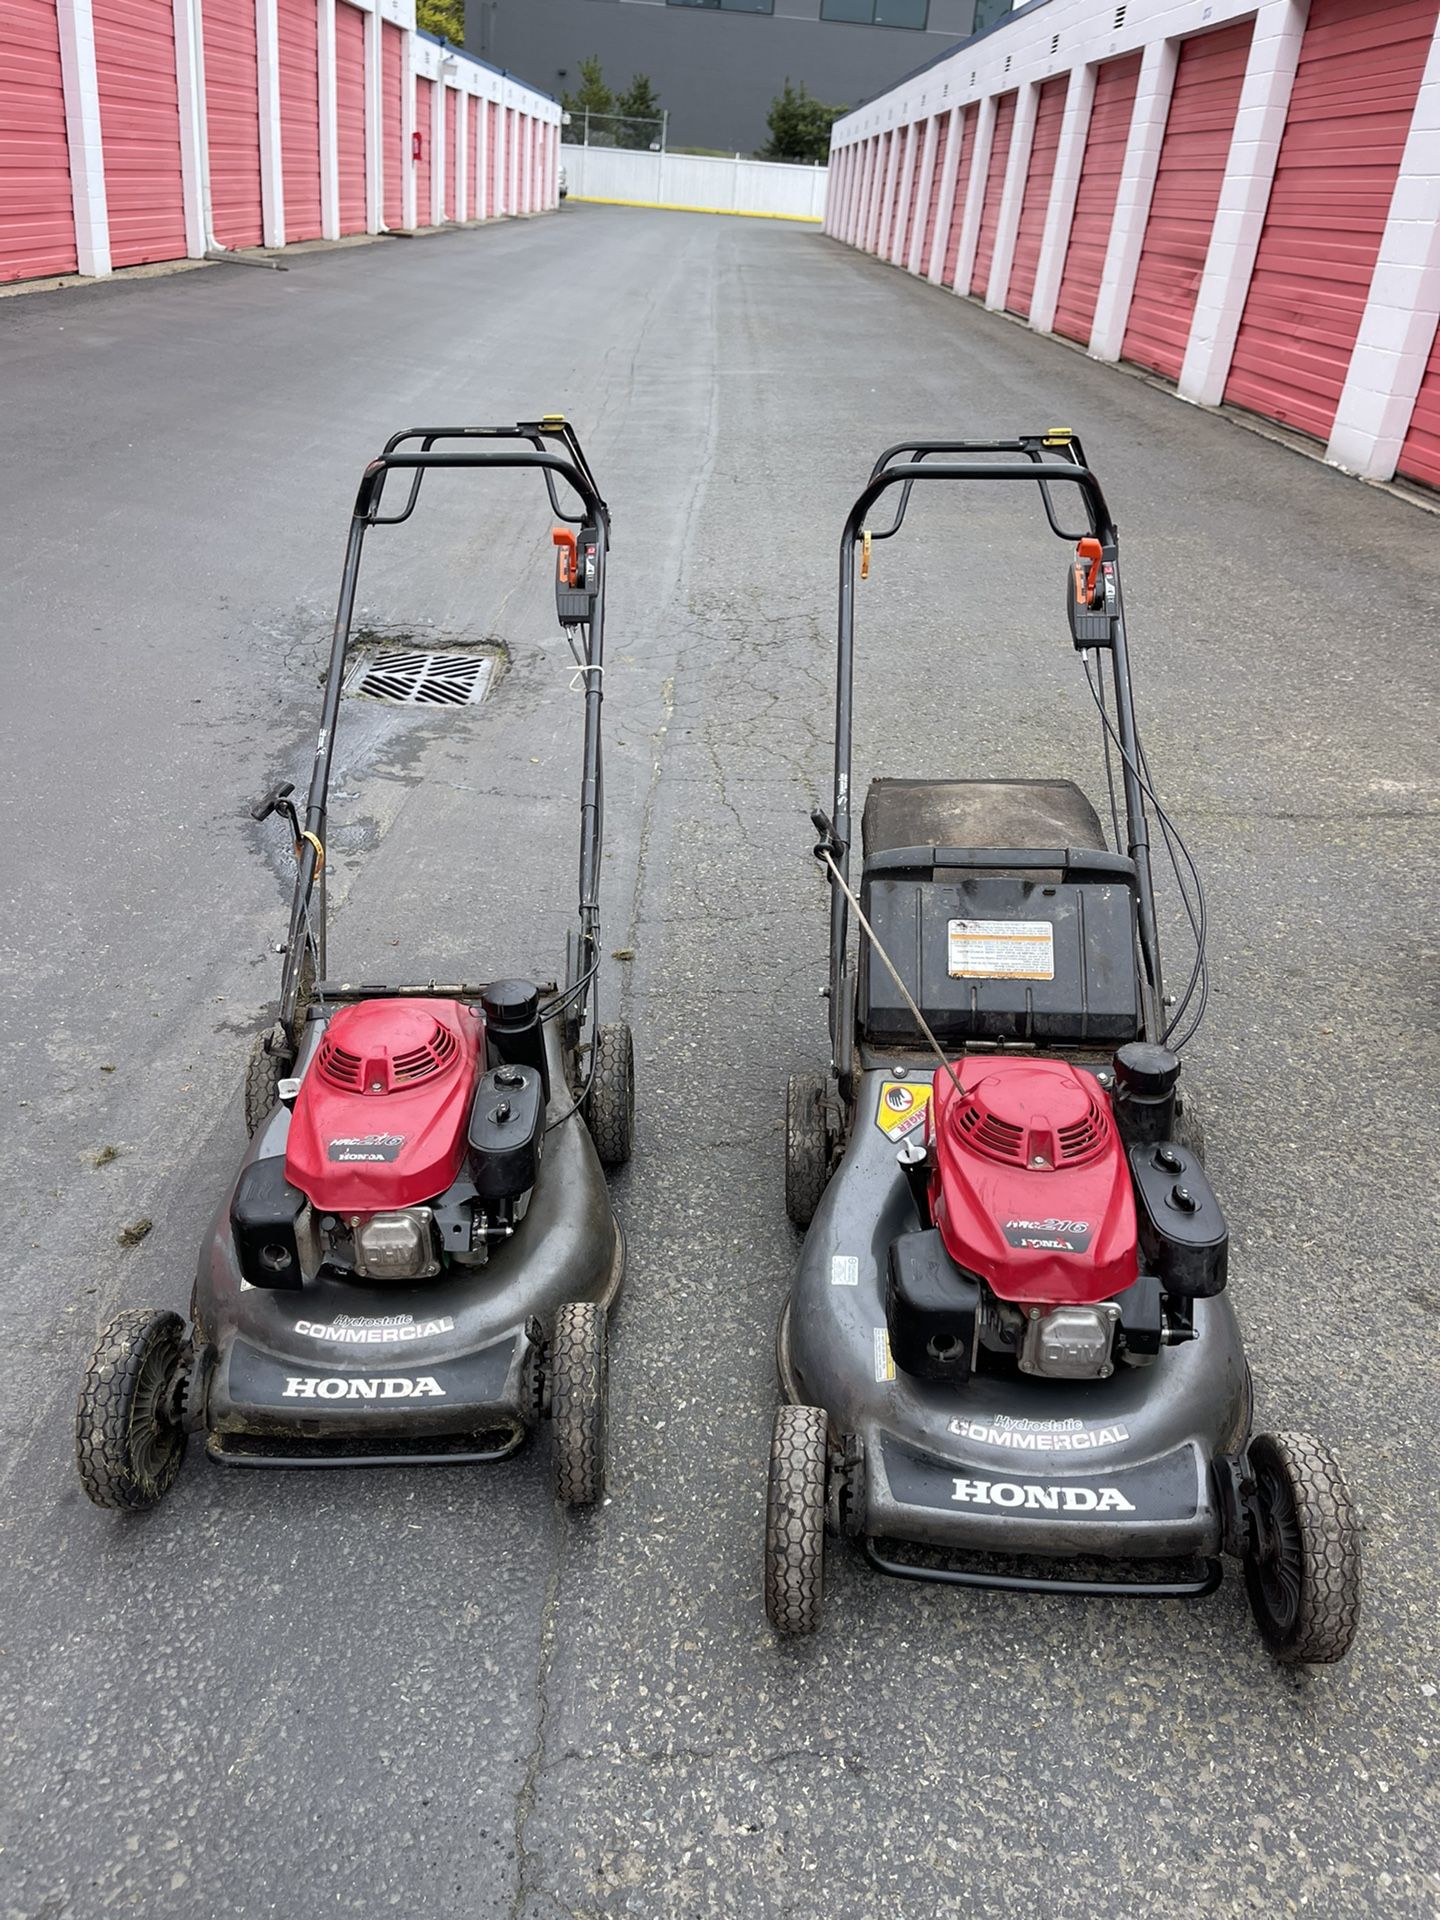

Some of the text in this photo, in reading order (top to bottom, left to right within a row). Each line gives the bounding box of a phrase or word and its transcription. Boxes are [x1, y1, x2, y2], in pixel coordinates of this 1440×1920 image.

[898, 1109, 926, 1133] NGER
[339, 1152, 385, 1161] HONDA
[294, 1317, 454, 1343] COMMERCIAL
[333, 1314, 413, 1328] Hydrostatic
[282, 1377, 447, 1399] HONDA
[949, 1418, 1130, 1450] COMMERCIAL
[994, 1415, 1084, 1432] Hydrostatic
[951, 1478, 1137, 1511] HONDA
